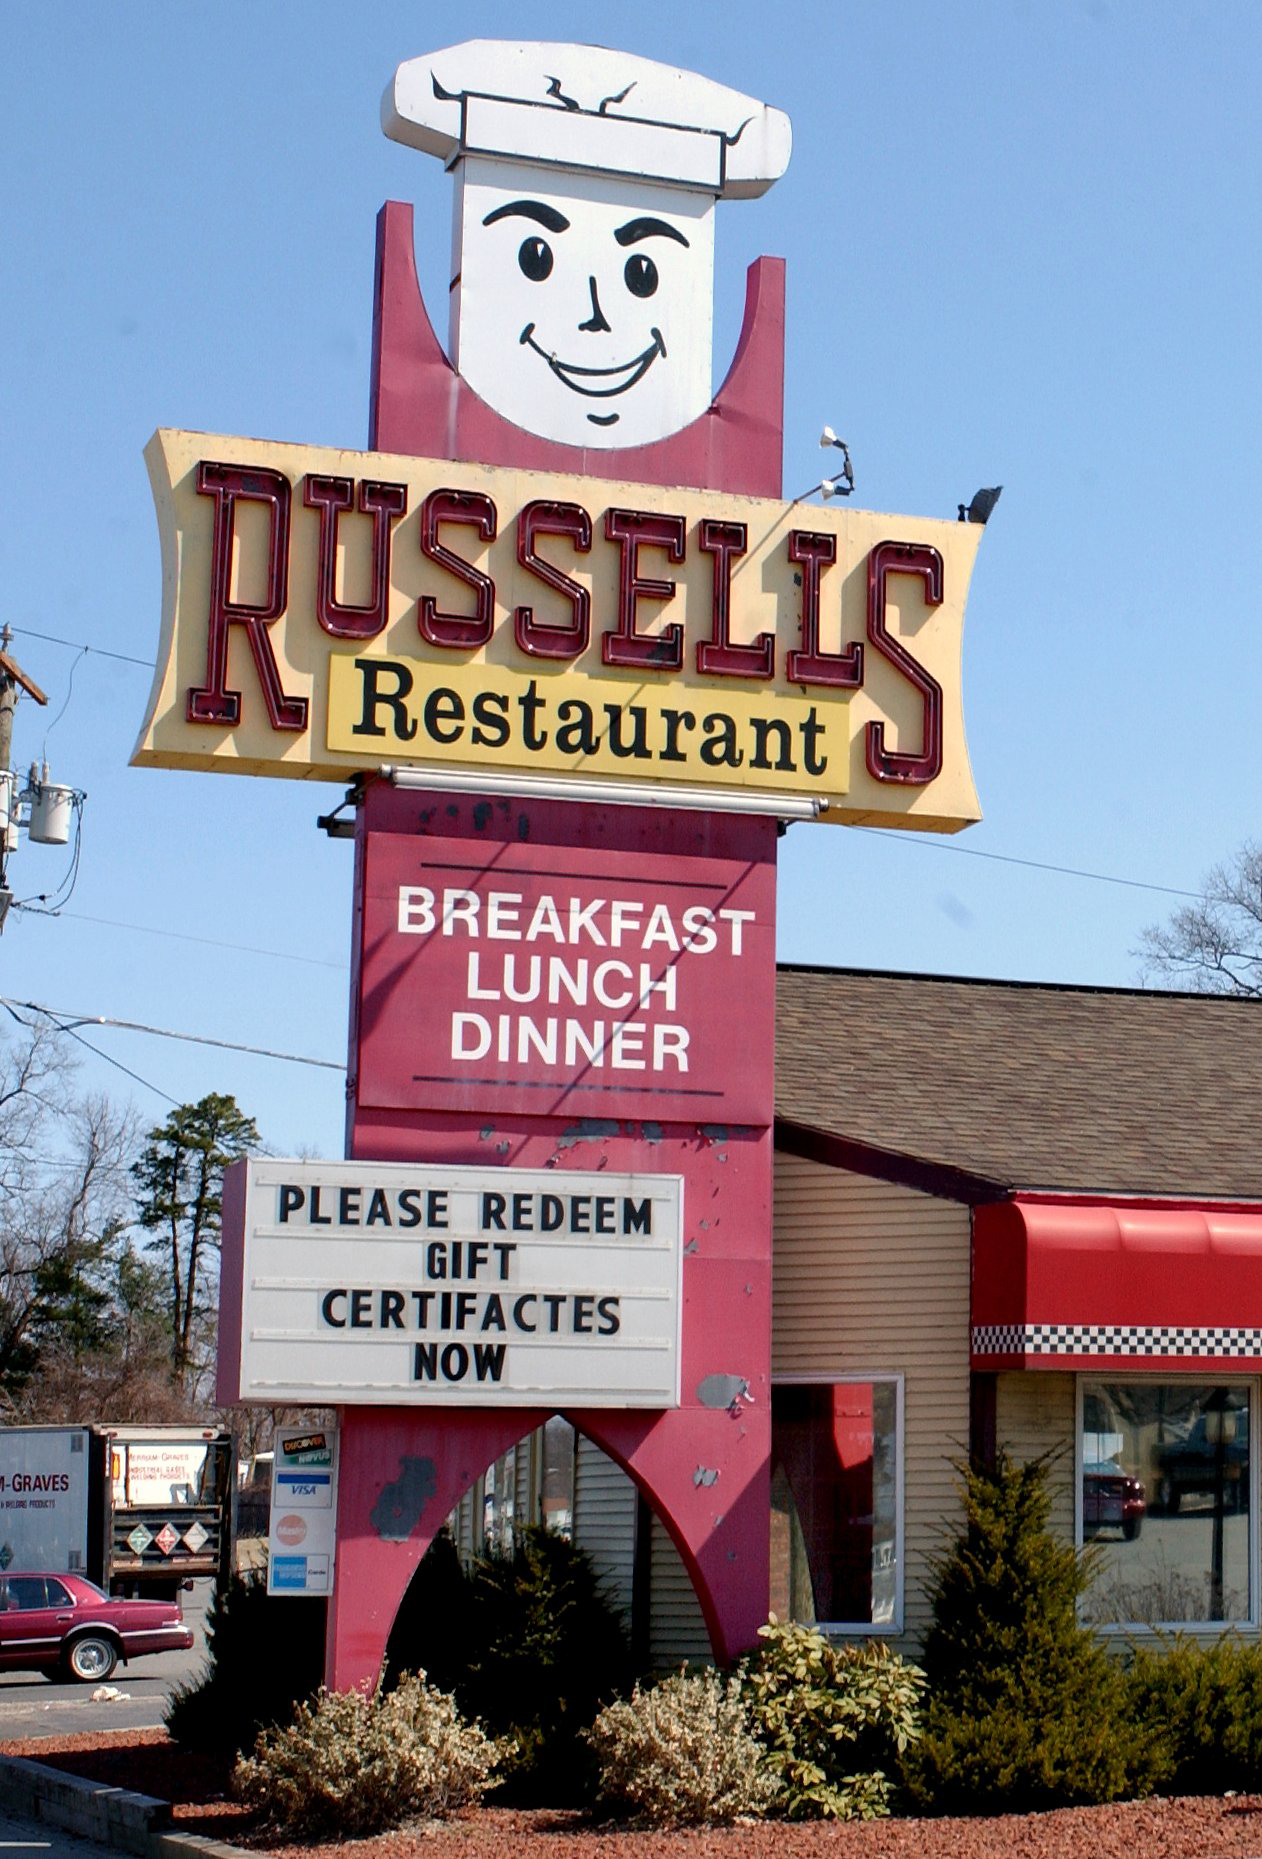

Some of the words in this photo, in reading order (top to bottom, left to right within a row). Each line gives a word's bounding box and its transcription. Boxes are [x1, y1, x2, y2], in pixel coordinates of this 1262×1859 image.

[185, 460, 943, 784] RUSSELLS
[351, 657, 828, 774] Restaurant
[398, 885, 756, 956] BREAKFAST
[467, 951, 677, 1011] LUNCH
[451, 1012, 690, 1072] DINNER
[279, 1185, 449, 1228] PLEASE
[482, 1192, 652, 1234] REDEEM
[427, 1242, 517, 1280] GIFT
[322, 1289, 621, 1335] CERTIFACTES
[414, 1343, 507, 1381] NOW
[292, 1485, 316, 1495] VISA
